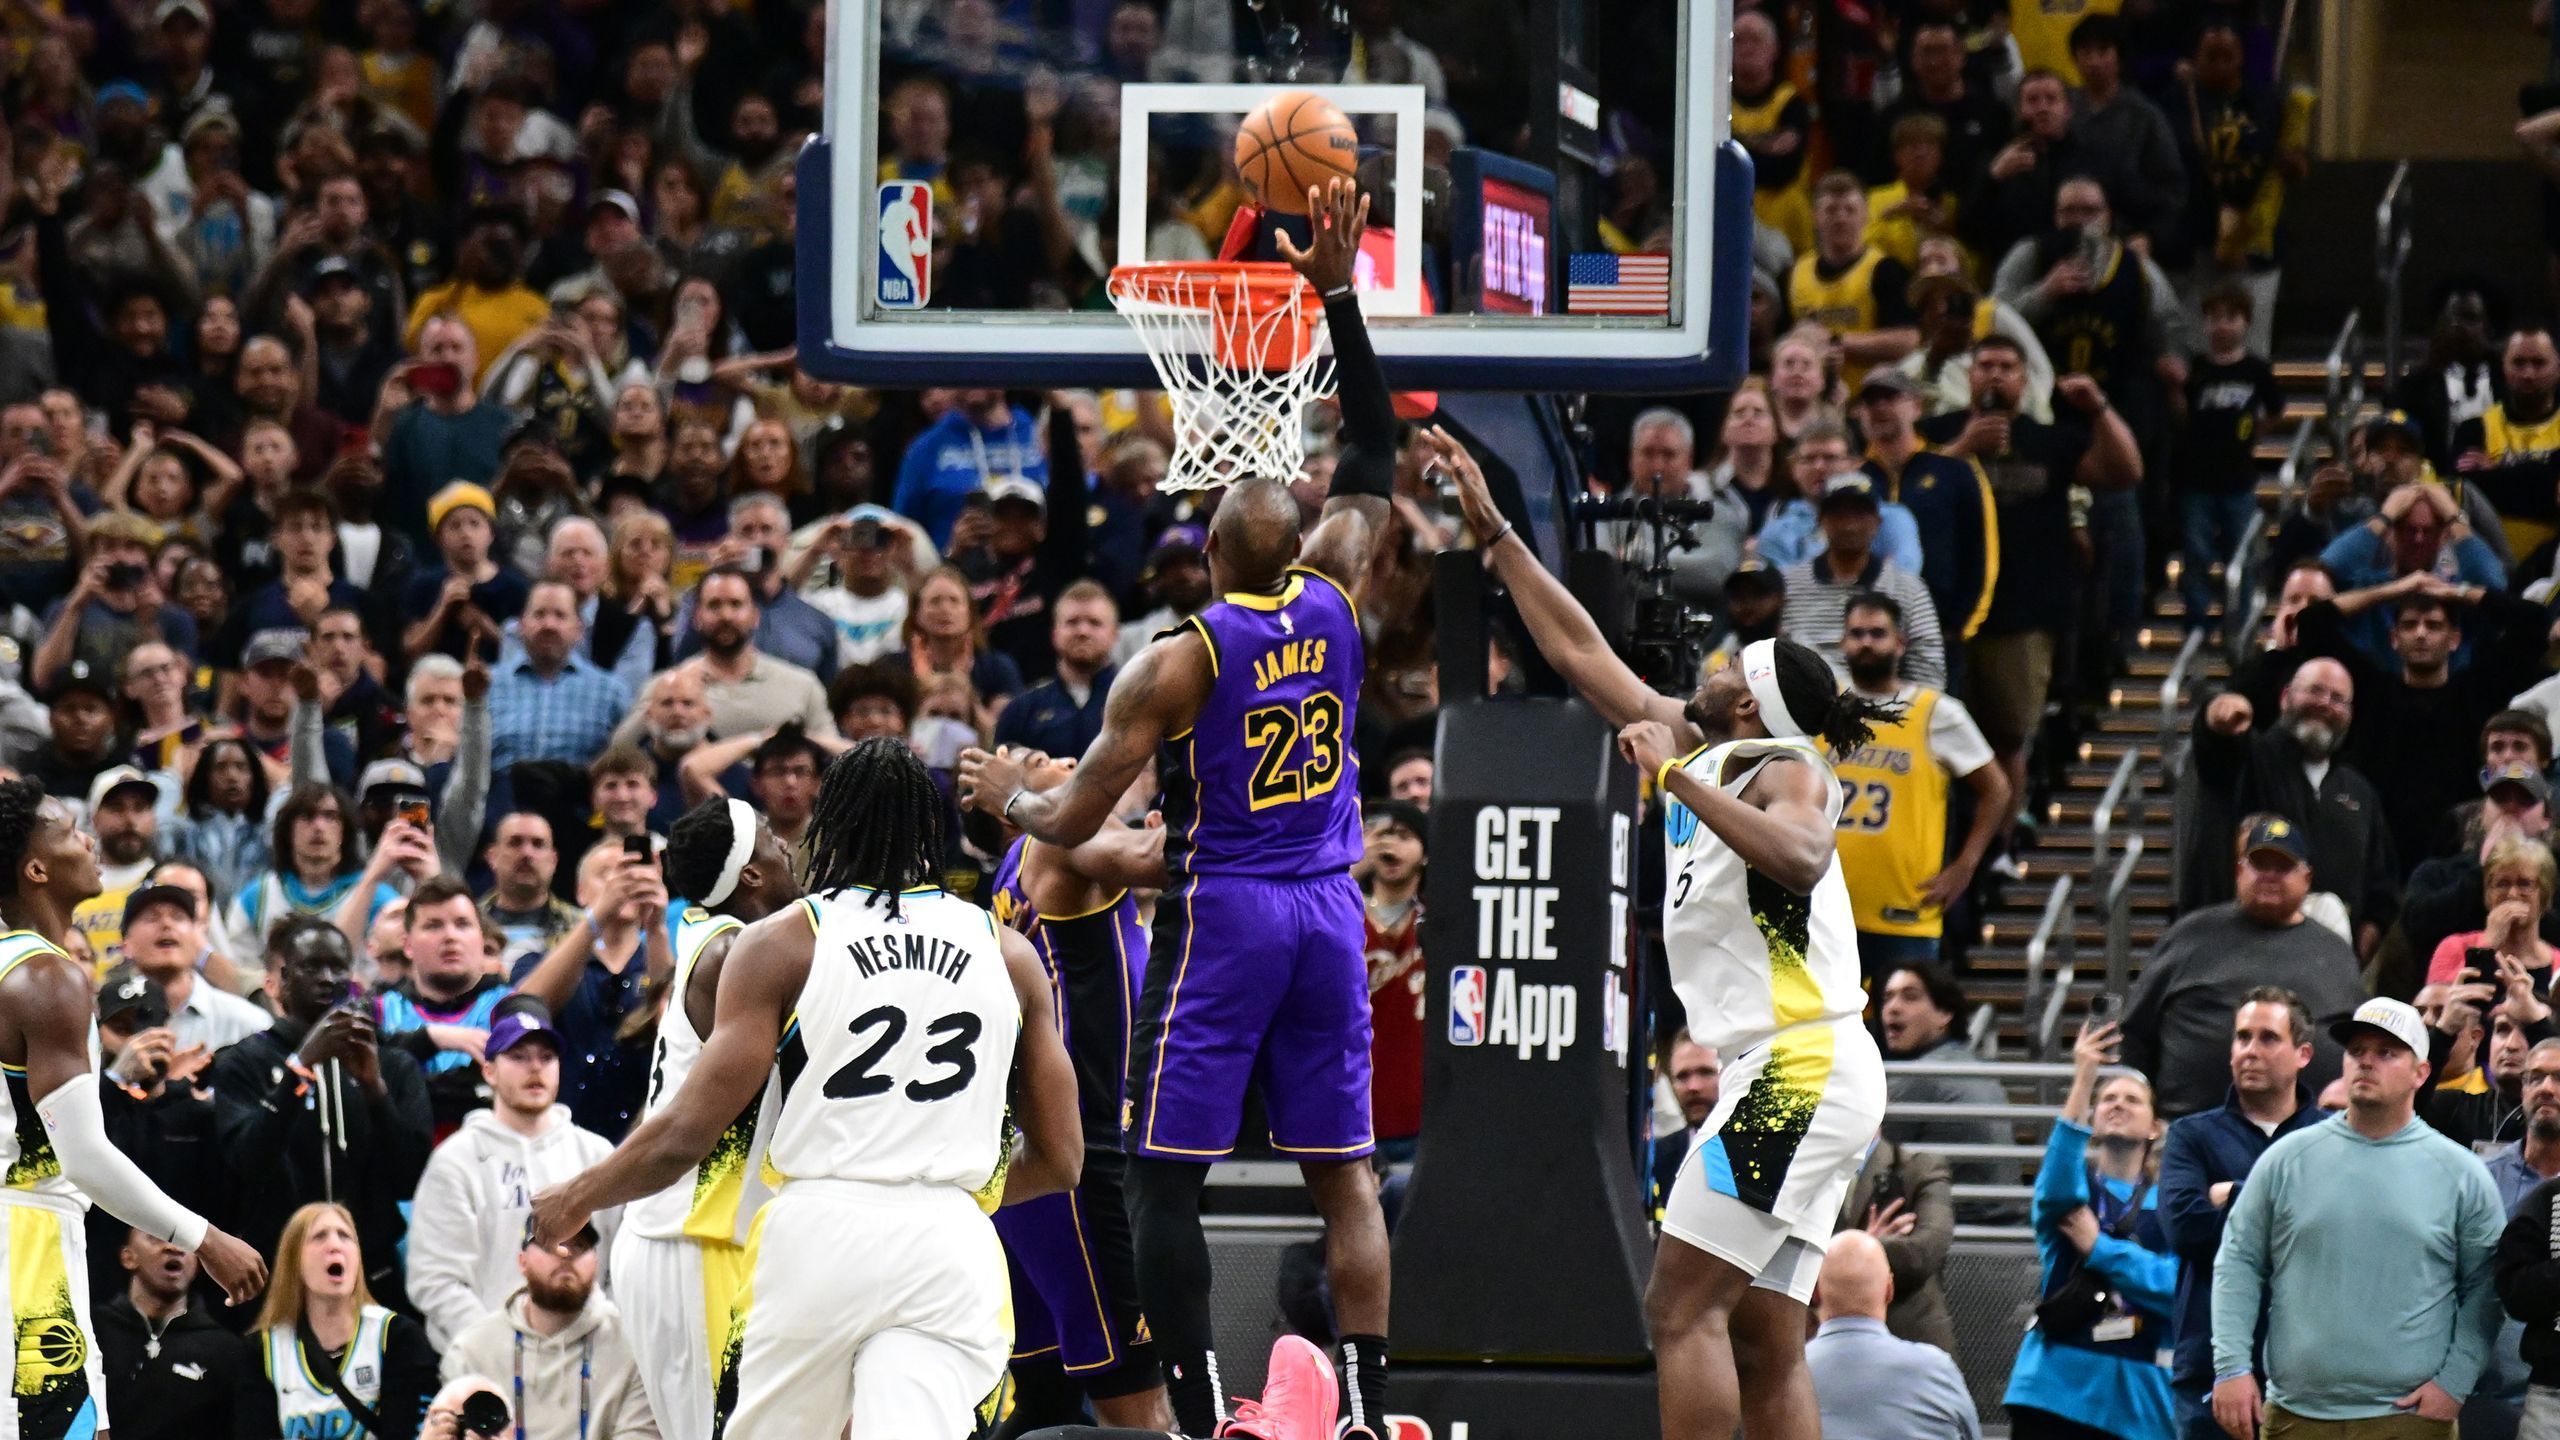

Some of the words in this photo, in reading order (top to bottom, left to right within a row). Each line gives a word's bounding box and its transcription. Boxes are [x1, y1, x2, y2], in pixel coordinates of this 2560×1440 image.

[882, 280, 909, 300] NBA
[1253, 639, 1327, 691] JAMES
[1244, 690, 1344, 812] 23
[1475, 805, 1561, 880] GET
[1673, 859, 1695, 908] 5
[847, 933, 972, 985] NESMITH
[1472, 886, 1560, 960] THE
[1489, 967, 1577, 1061] App
[822, 1004, 982, 1102] 23
